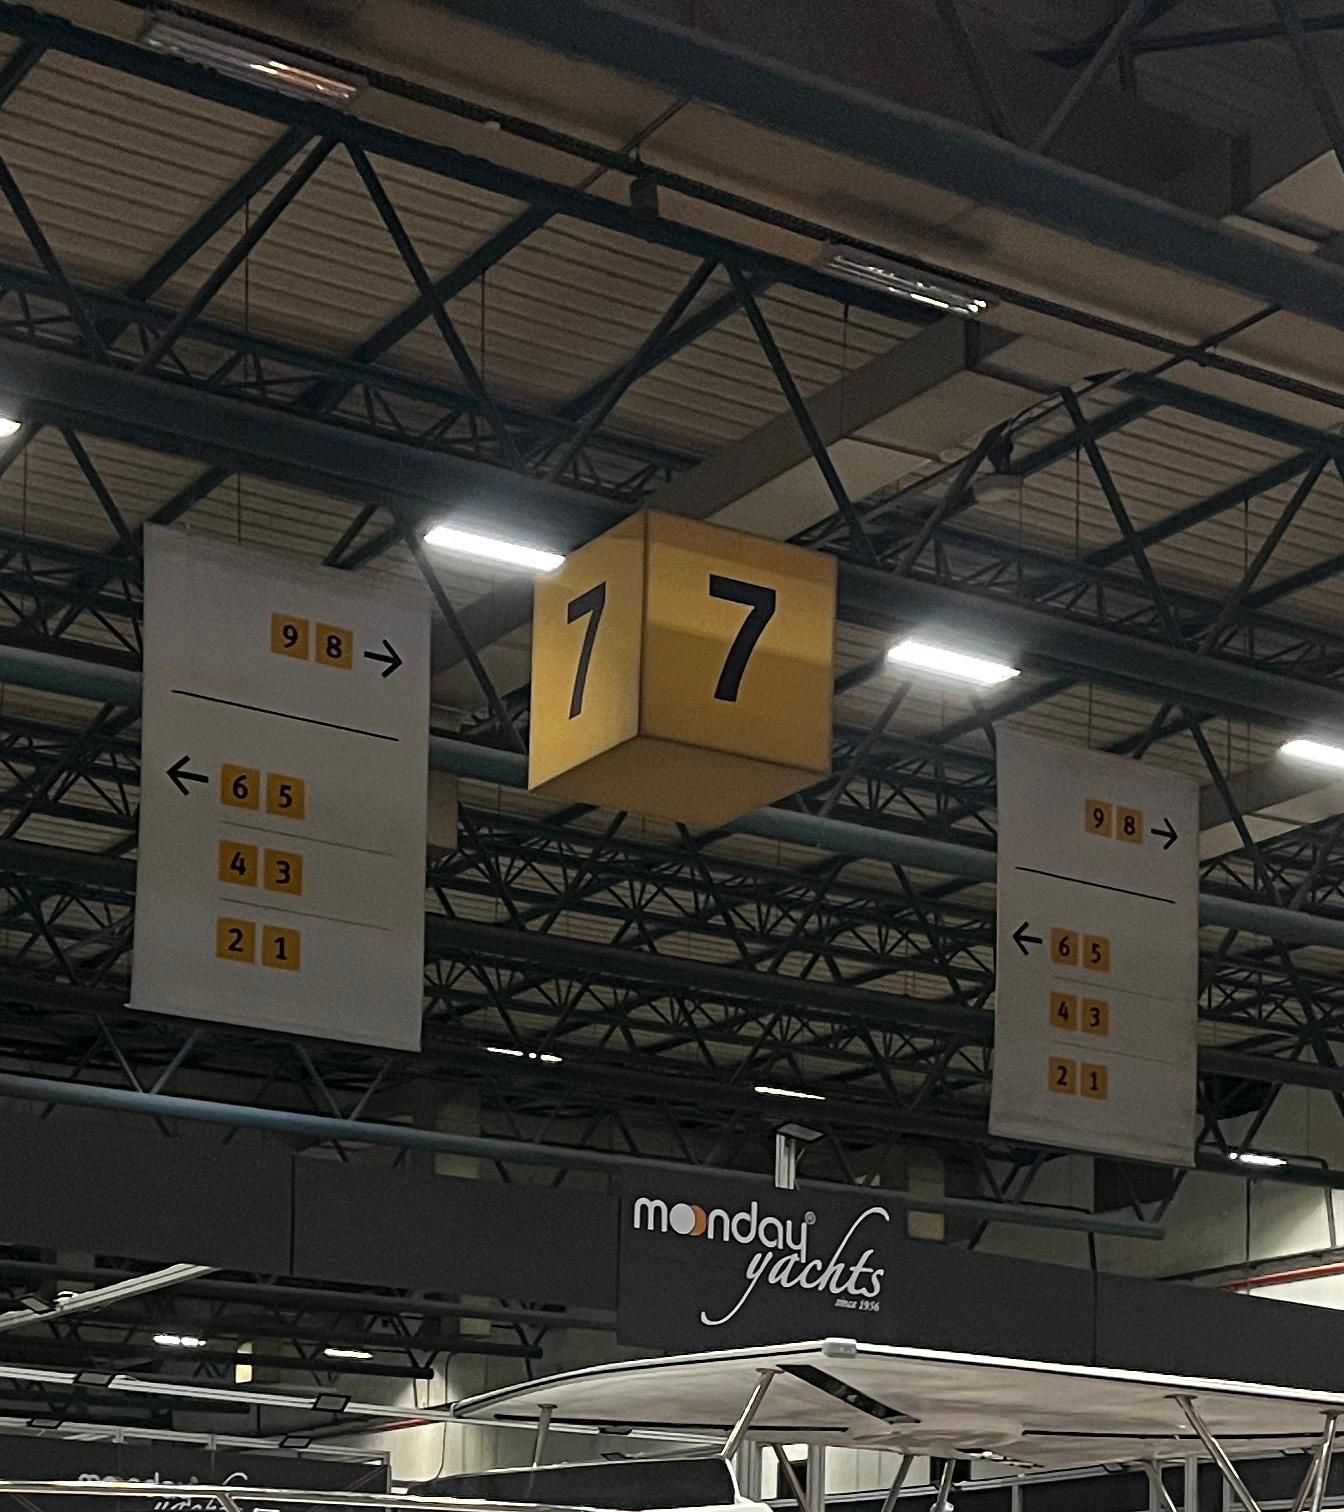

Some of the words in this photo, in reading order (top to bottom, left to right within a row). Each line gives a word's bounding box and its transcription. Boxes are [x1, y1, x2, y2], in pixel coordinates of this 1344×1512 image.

[282, 624, 298, 648] 9
[326, 635, 342, 660] 8
[568, 580, 606, 720] 7
[709, 573, 777, 703] 7
[232, 775, 248, 800] 6
[278, 784, 293, 808] 5
[1092, 808, 1105, 829] 9
[1123, 815, 1136, 836] 8
[230, 852, 246, 876] 4
[275, 860, 291, 884] 3
[228, 928, 243, 952] 2
[274, 937, 287, 960] 1
[1058, 935, 1071, 957] 6
[1091, 943, 1102, 965] 5
[1057, 1000, 1069, 1022] 4
[1089, 1006, 1101, 1028] 3
[1056, 1065, 1068, 1087] 2
[1089, 1071, 1099, 1092] 1
[701, 1206, 890, 1326] yachts
